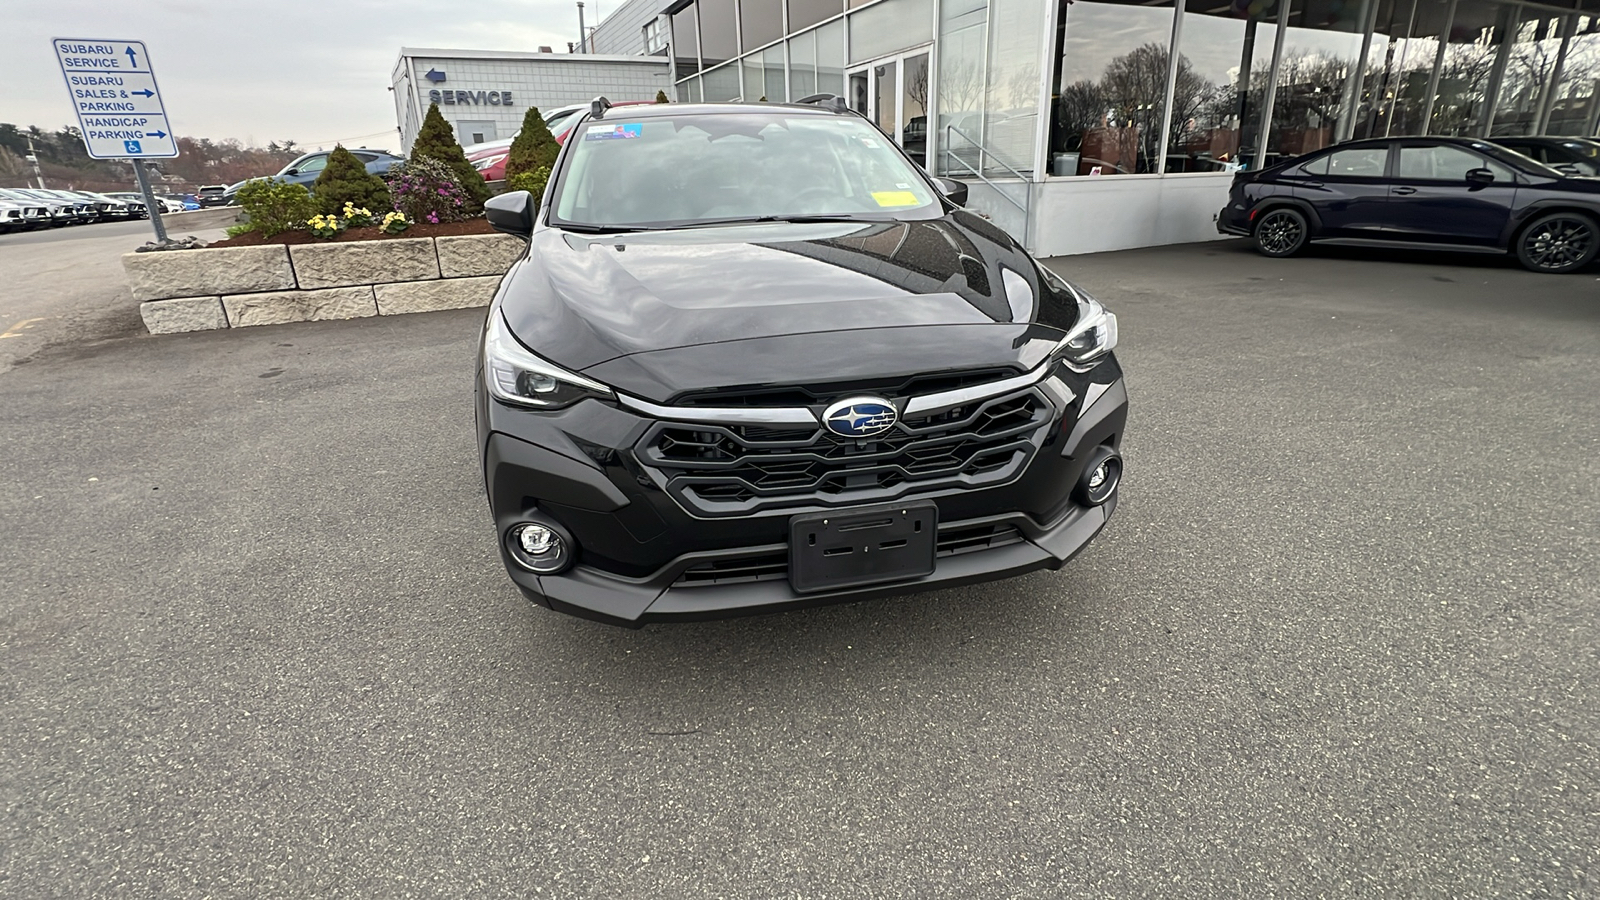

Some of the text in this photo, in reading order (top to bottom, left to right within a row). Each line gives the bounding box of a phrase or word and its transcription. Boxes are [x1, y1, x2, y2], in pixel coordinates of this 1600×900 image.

[60, 44, 114, 55] SUBARU
[64, 57, 120, 68] SERVICE
[71, 76, 124, 86] SUBARU
[75, 89, 129, 99] SALES &
[429, 89, 514, 106] SERVICE
[79, 102, 135, 111] PARKING
[85, 118, 148, 127] HANDICAP
[90, 131, 144, 139] PARKING
